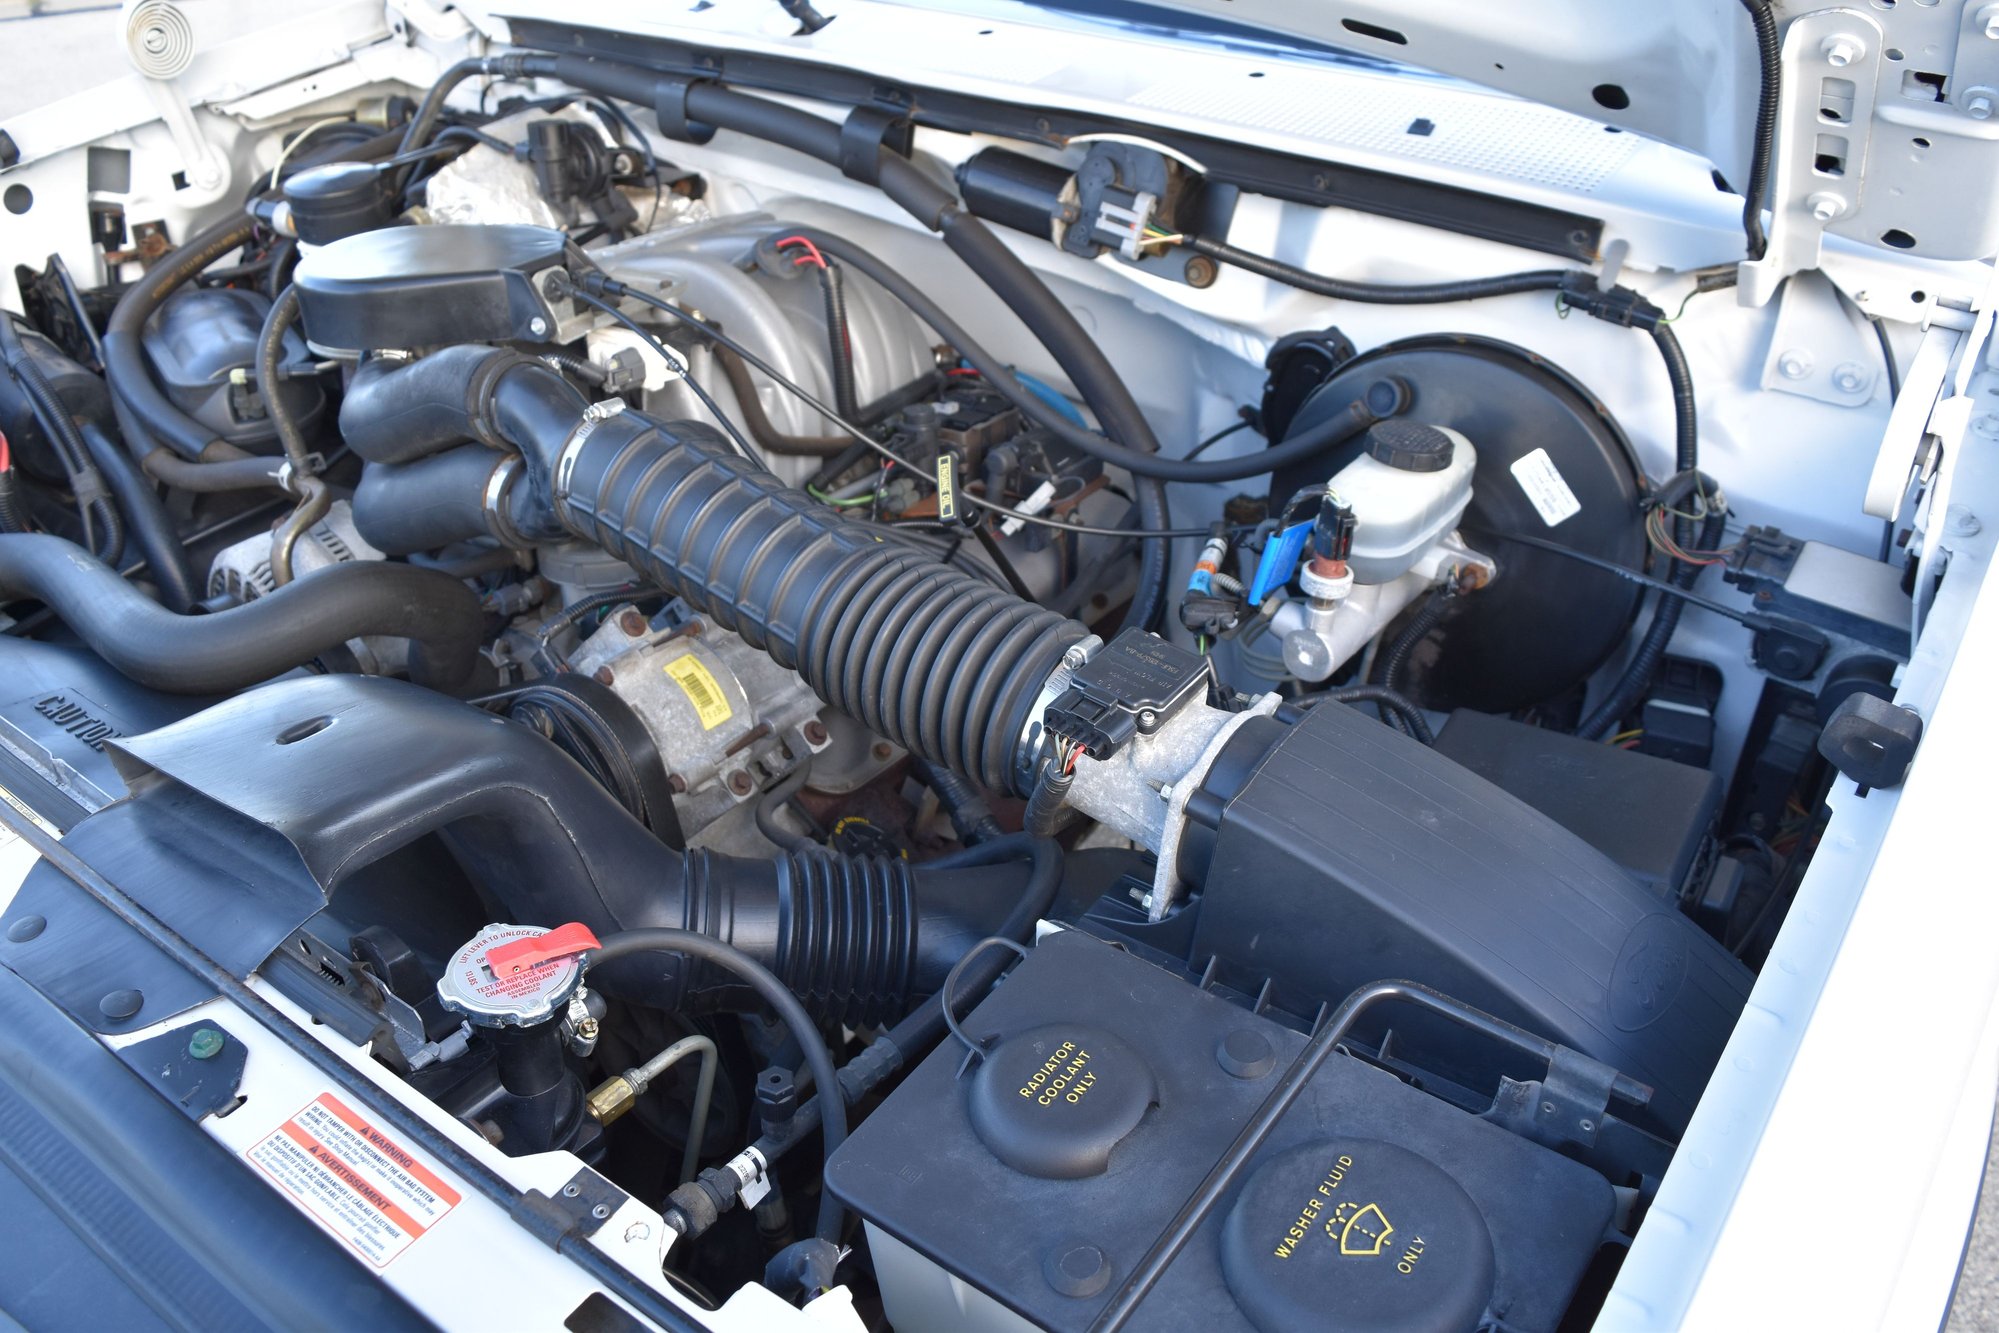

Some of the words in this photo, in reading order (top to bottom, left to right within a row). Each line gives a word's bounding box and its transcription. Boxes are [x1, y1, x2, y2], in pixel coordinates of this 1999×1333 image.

[941, 463, 950, 492] ENGINE
[942, 494, 951, 509] OIL
[459, 953, 471, 964] LIFT
[468, 939, 488, 954] LEVER
[500, 930, 531, 938] UNLOCK
[476, 984, 493, 994] TEST
[495, 979, 505, 988] OR
[506, 971, 537, 984] REPLACE
[537, 962, 560, 974] WHEN
[485, 982, 523, 998] CHANGING
[524, 970, 557, 985] COOLANT
[507, 982, 540, 996] ASSEMBLED
[518, 987, 540, 998] MEXICO
[1019, 1041, 1076, 1098] RADIATOR
[1038, 1050, 1091, 1106] COOLANT
[1066, 1071, 1097, 1104] ONLY
[317, 1110, 328, 1119] NOT
[326, 1117, 345, 1132] TAMPER
[343, 1130, 356, 1141] WITH
[360, 1144, 390, 1167] DISCONNECT
[388, 1166, 399, 1174] THE
[397, 1173, 407, 1181] AIR
[405, 1179, 417, 1188] BAG
[415, 1186, 435, 1203] SYSTEM
[367, 1132, 413, 1168] WARNING
[280, 1140, 290, 1148] PAS
[288, 1146, 314, 1167] MANIPULER
[318, 1169, 348, 1195] DÉBRANCHER
[371, 1214, 401, 1238] ÉLECTRIQUE
[317, 1151, 391, 1211] AVERTISSEMENT
[1274, 1198, 1323, 1259] WASHER
[1318, 1155, 1352, 1196] FLUID
[1397, 1235, 1426, 1274] ONLY
